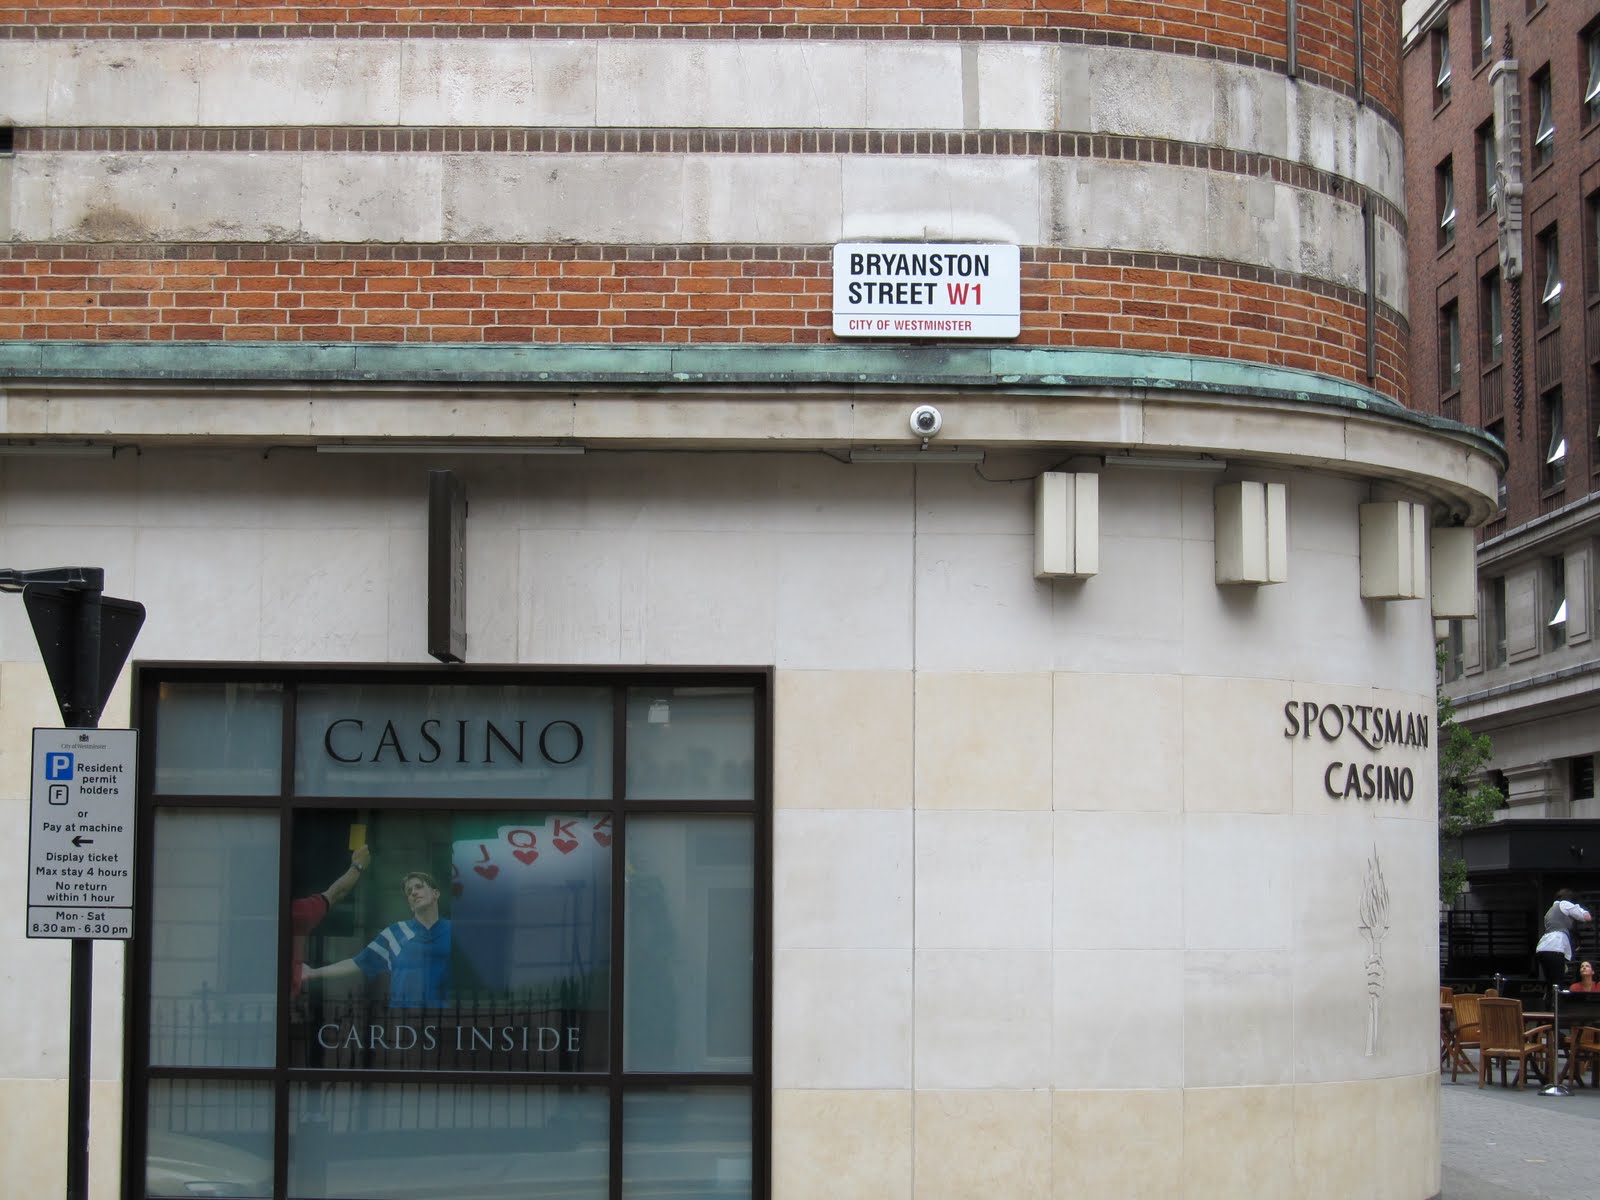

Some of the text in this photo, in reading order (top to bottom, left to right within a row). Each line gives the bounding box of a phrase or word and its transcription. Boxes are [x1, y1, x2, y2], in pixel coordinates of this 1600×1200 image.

[850, 253, 990, 277] BRYANSTON
[848, 282, 982, 305] STREET W1
[849, 319, 972, 331] CITY OF WESTMINSTER
[1284, 700, 1429, 751] SPORTSMAN
[324, 719, 584, 764] CASINO
[52, 755, 70, 778] P
[77, 763, 124, 773] Resident
[82, 775, 117, 785] permit
[1324, 761, 1414, 802] CASINO
[55, 789, 63, 799] F
[80, 786, 119, 795] holders
[43, 822, 123, 833] Pay at machine
[553, 818, 578, 839] K
[507, 829, 538, 850] Q
[46, 852, 119, 863] Display ticket
[36, 866, 128, 878] Max stay 4 hours
[55, 881, 107, 891] No return
[47, 892, 115, 902] within 1 hour
[56, 911, 78, 920] Mon
[87, 912, 105, 921] Sat
[33, 923, 58, 933] 8.30
[60, 925, 76, 933] am
[84, 924, 110, 934] 6.30
[112, 925, 128, 935] pm
[317, 1024, 581, 1052] CARDS INSIDE
